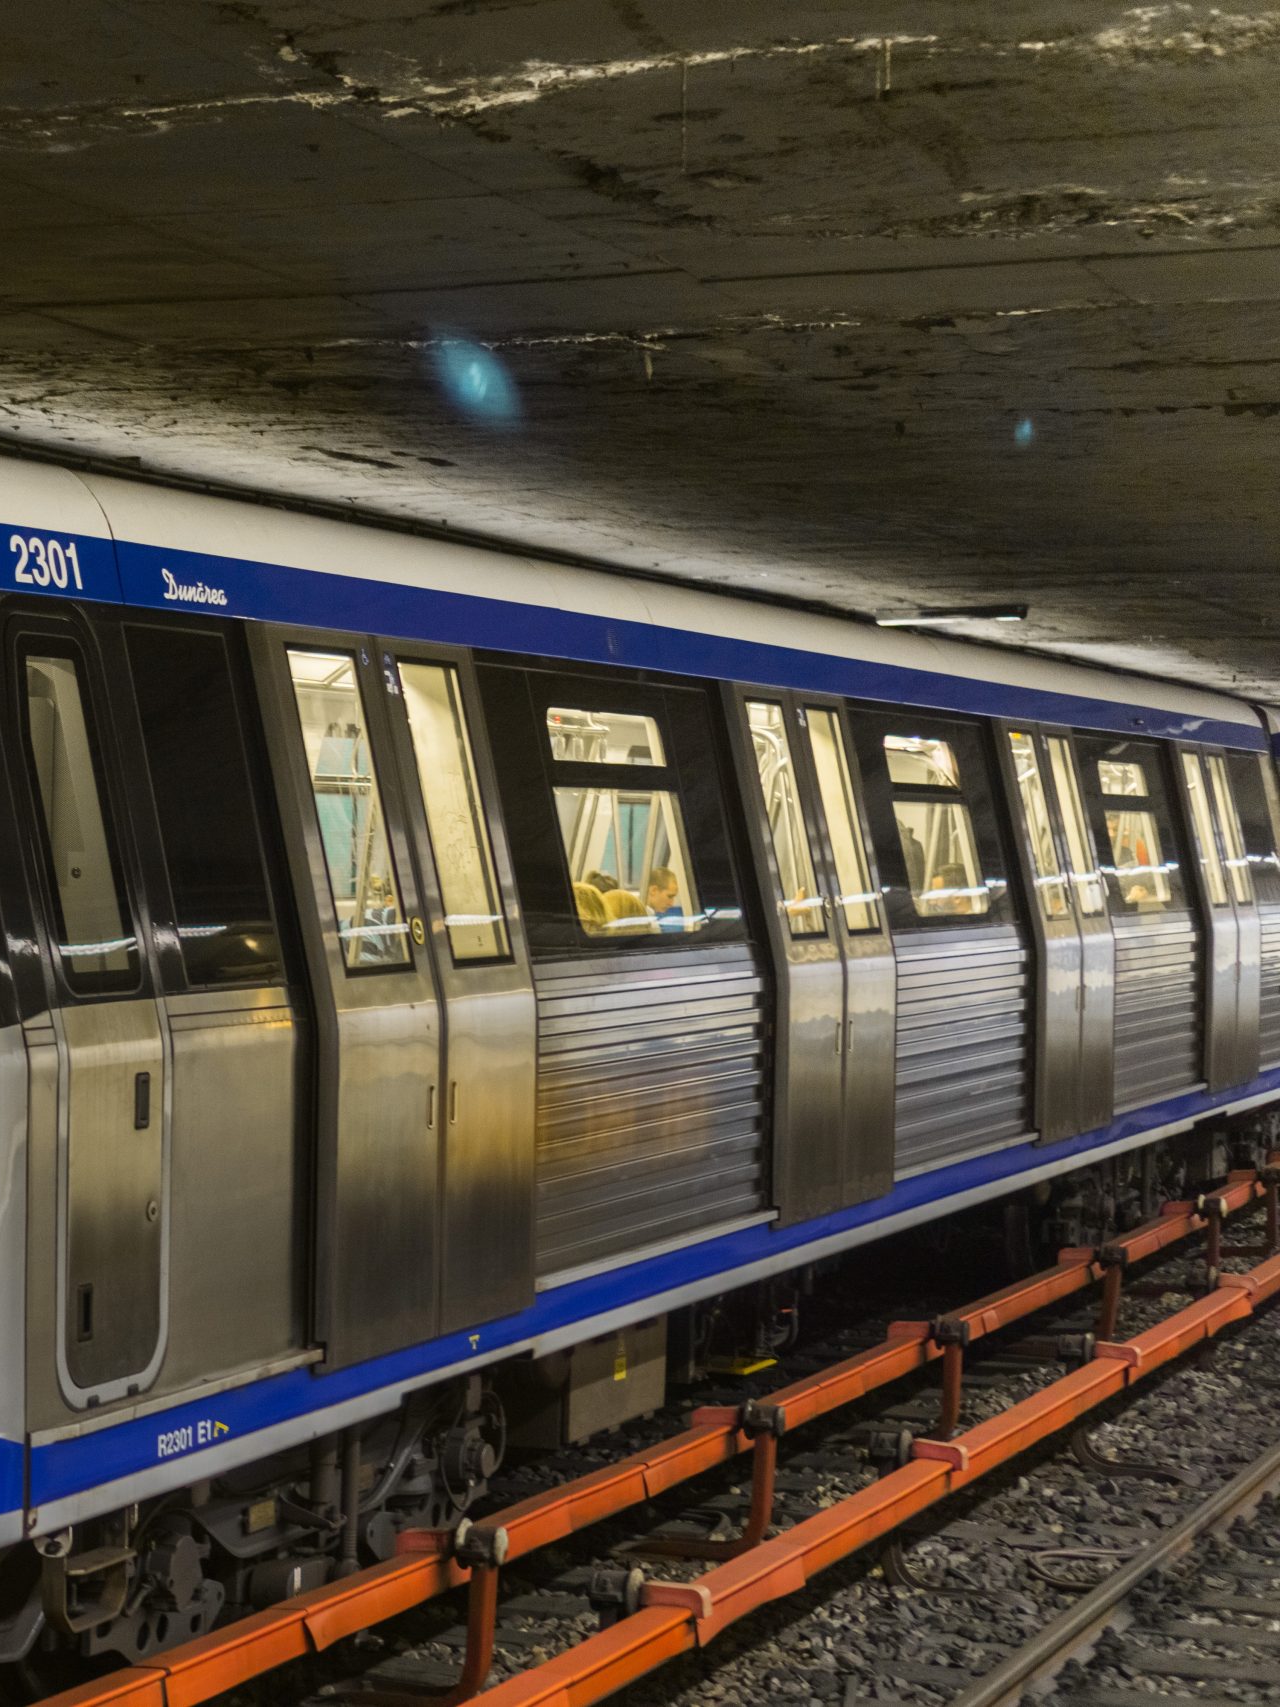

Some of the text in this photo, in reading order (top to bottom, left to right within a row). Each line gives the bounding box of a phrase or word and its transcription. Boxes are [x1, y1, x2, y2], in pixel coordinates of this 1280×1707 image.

[10, 534, 83, 590] 2301
[161, 568, 228, 606] Dunărea
[157, 1419, 212, 1458] R2301 E1
